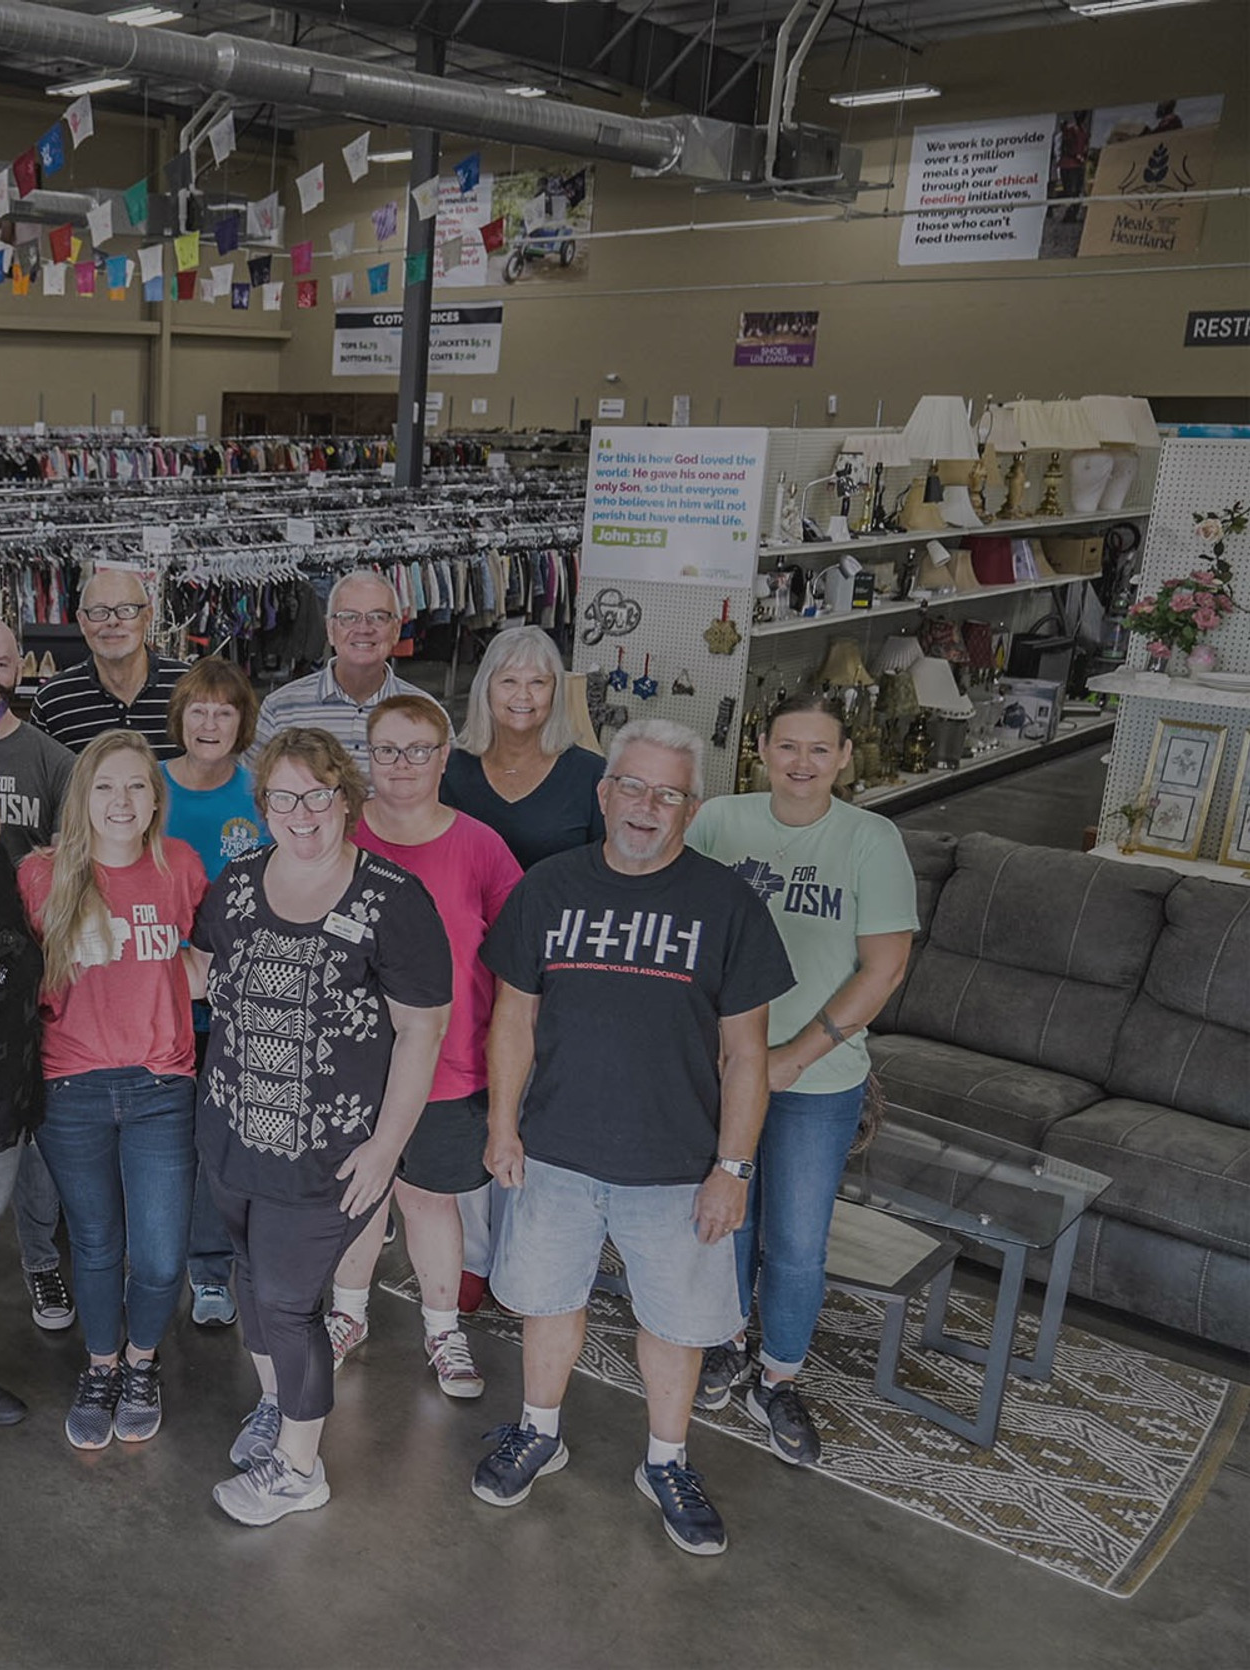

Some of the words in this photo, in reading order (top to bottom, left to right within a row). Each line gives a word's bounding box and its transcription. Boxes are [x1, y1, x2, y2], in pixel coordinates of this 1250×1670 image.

[926, 141, 946, 152] We
[948, 138, 978, 150] work
[981, 137, 994, 147] to
[995, 131, 1045, 149] provide
[924, 156, 951, 165] over
[953, 154, 969, 166] 1.5
[971, 149, 1015, 161] million
[922, 167, 959, 179] meals
[971, 164, 998, 177] year
[922, 179, 969, 192] through
[971, 178, 993, 188] our
[994, 173, 1039, 187] ethical
[920, 193, 966, 205] feeding
[967, 189, 1031, 202] initiatives,
[916, 221, 949, 231] those
[951, 219, 977, 229] who
[979, 216, 1011, 228] can't
[1114, 215, 1153, 231] Meals
[915, 233, 942, 244] feed
[944, 230, 1017, 243] themselves.
[1110, 230, 1176, 251] Heartland
[431, 311, 459, 323] RICES
[597, 452, 614, 463] For
[616, 453, 636, 463] this
[638, 454, 646, 464] is
[648, 454, 673, 464] how
[674, 454, 699, 465] God
[700, 454, 734, 465] loved
[736, 455, 756, 466] the
[596, 468, 631, 478] world:
[632, 468, 649, 478] He
[650, 471, 678, 482] gave
[679, 469, 696, 480] his
[698, 472, 720, 480] one
[722, 470, 746, 481] and
[594, 482, 618, 494] only
[644, 484, 657, 493] so
[660, 484, 684, 494] that
[685, 486, 740, 497] everyone
[593, 496, 617, 506] who
[618, 497, 665, 508] believes
[667, 498, 678, 508] in
[679, 498, 702, 509] him
[703, 500, 725, 511] will
[727, 501, 746, 511] not
[592, 510, 626, 522] perish
[627, 511, 647, 521] but
[648, 512, 676, 522] have
[678, 514, 720, 525] eternal
[722, 514, 745, 526] life.
[597, 528, 631, 543] John
[632, 531, 663, 545] 3:16
[791, 865, 817, 882] FOR
[784, 883, 842, 921] DSM
[132, 904, 158, 924] FOR
[134, 925, 179, 961] DSM
[576, 962, 639, 974] MOTORCYCLISTS
